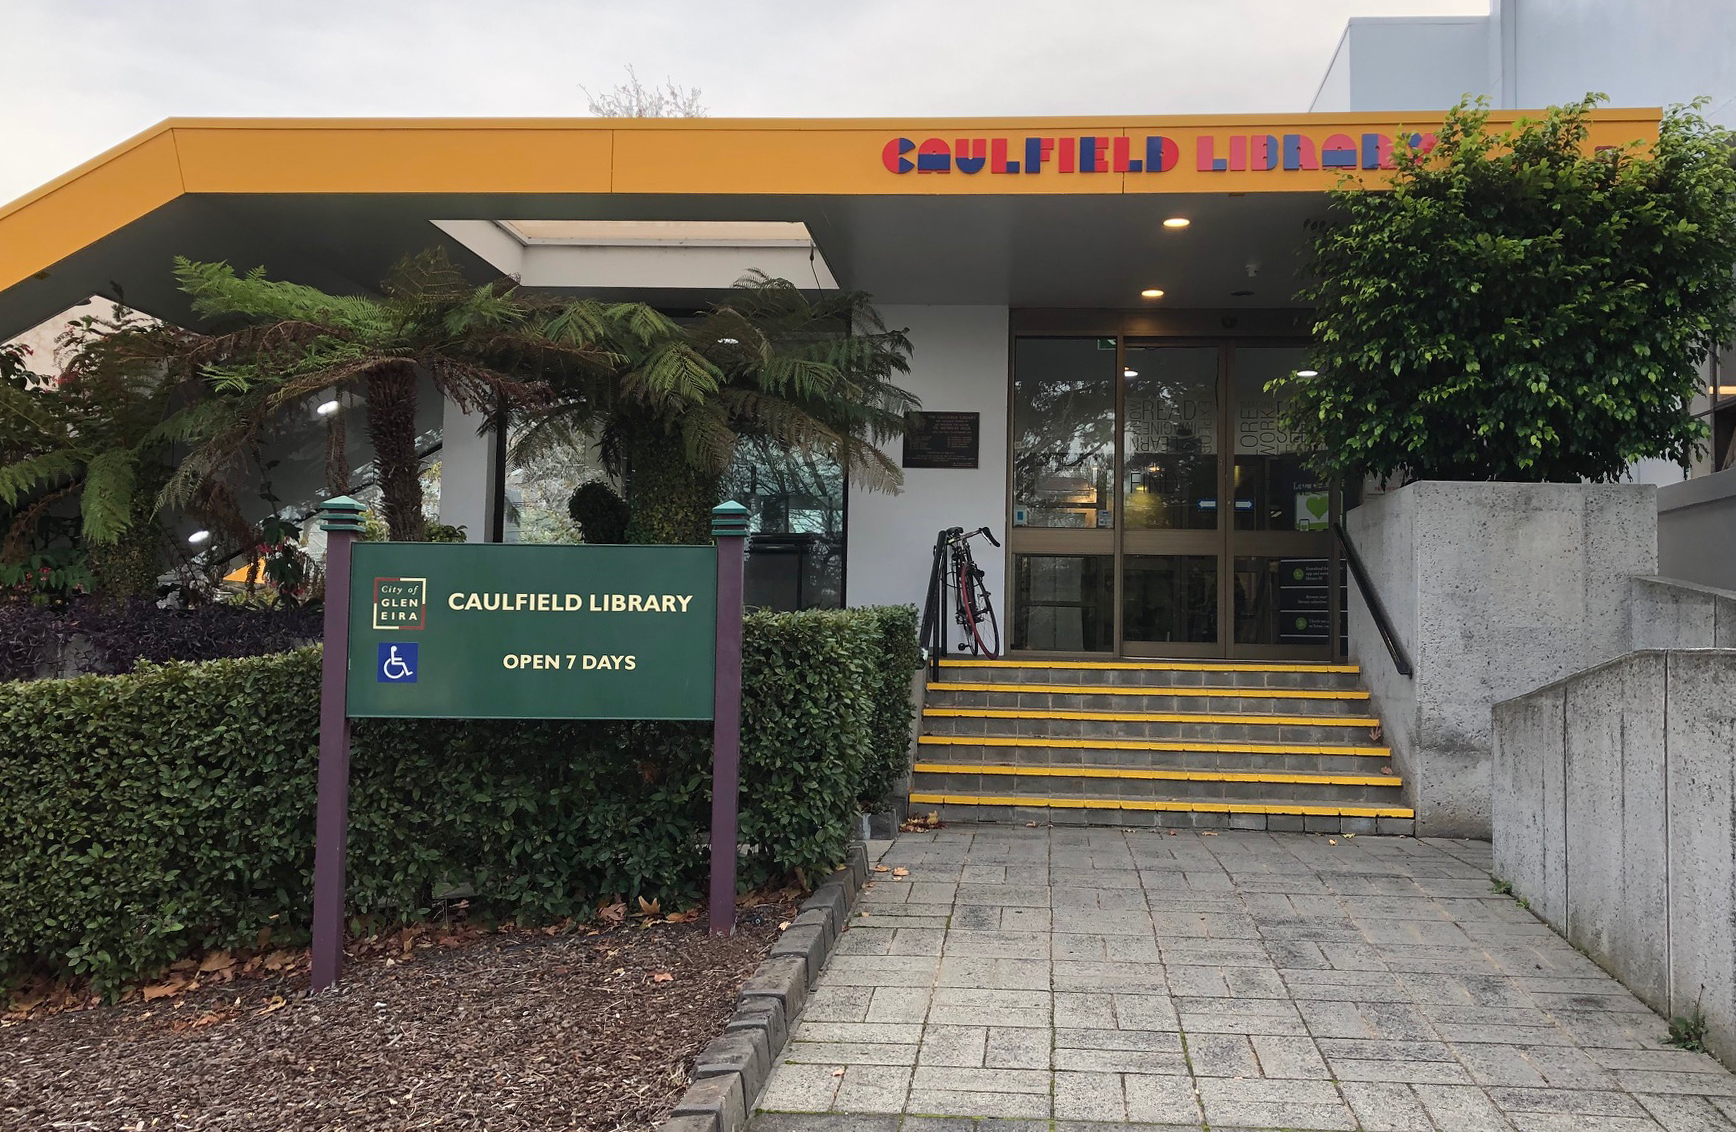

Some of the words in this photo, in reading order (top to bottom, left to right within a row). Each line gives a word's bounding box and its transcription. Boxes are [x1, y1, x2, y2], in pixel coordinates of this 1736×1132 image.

[882, 136, 1180, 174] CAULFIELD
[1142, 399, 1197, 421] READ
[381, 584, 403, 595] City
[407, 584, 419, 595] of
[381, 598, 418, 608] GLEN
[448, 592, 583, 612] CAULFIELD
[589, 594, 693, 613] LIBRARY
[381, 611, 418, 621] EIRA
[502, 653, 560, 670] OPEN
[565, 654, 577, 670] 7
[582, 654, 636, 671] DAYS
